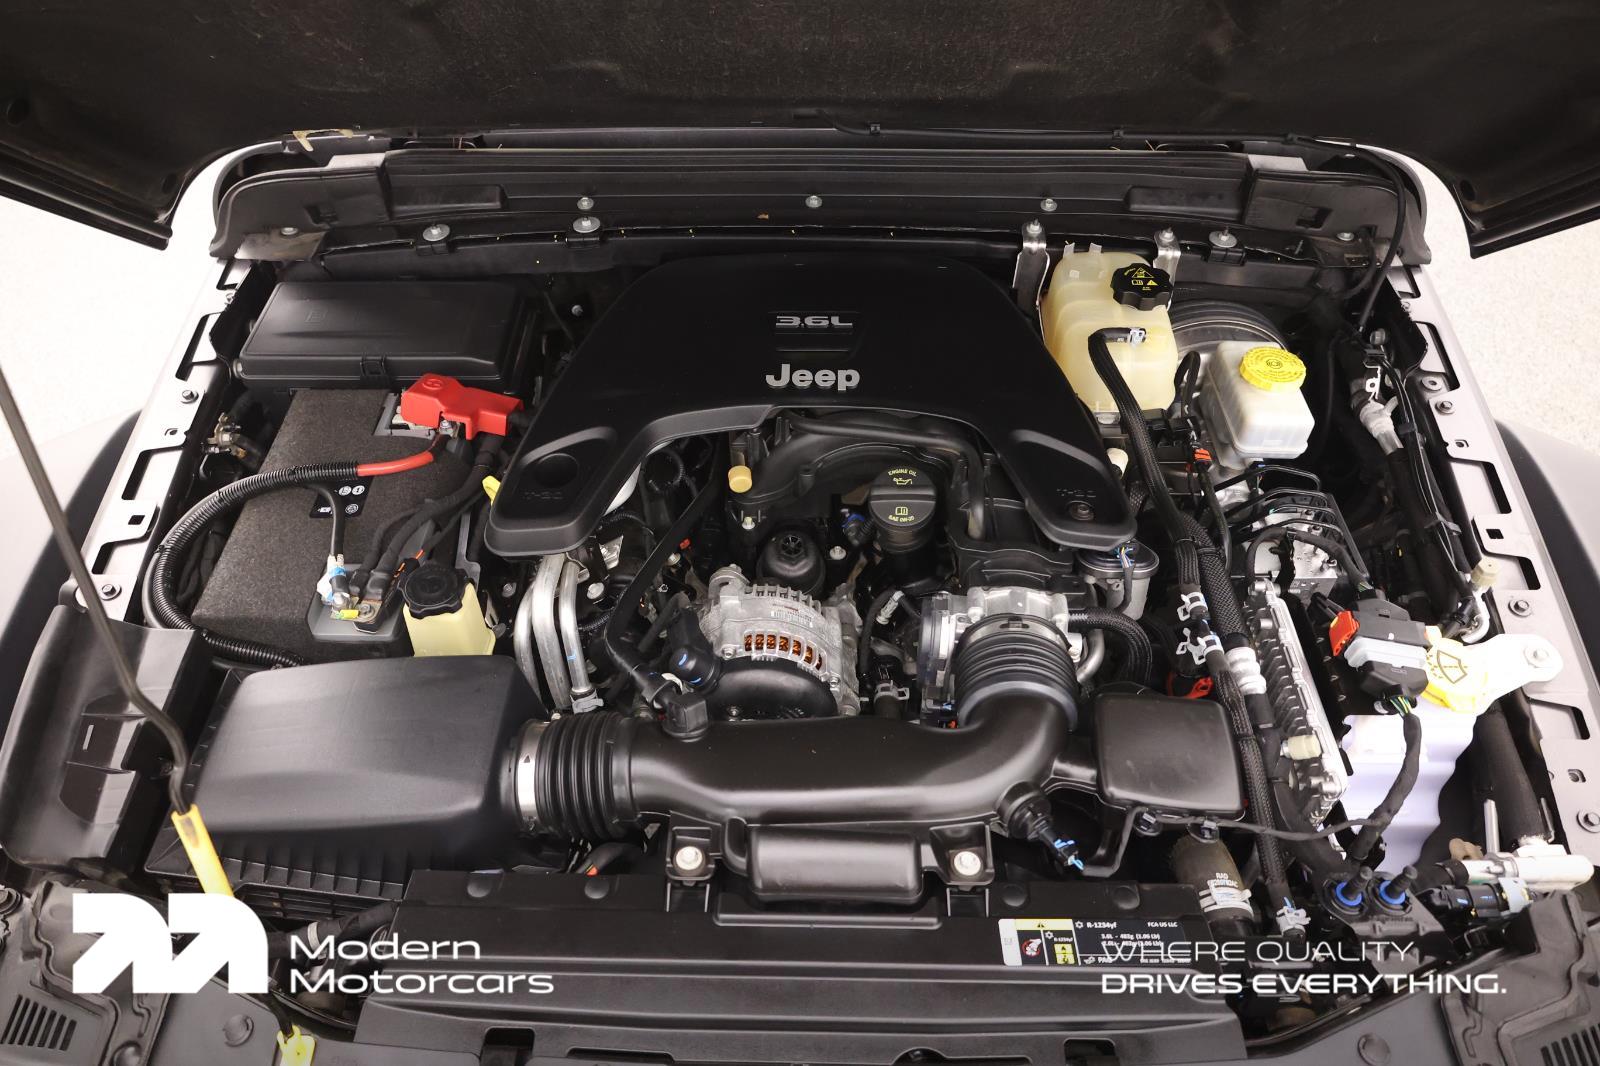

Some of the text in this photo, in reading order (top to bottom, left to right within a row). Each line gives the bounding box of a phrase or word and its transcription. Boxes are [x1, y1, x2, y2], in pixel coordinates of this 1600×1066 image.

[775, 315, 853, 328] 3.6L
[765, 363, 861, 391] Jeep
[888, 468, 917, 477] ENGINE OIL
[1086, 921, 1118, 930] R-1234yf
